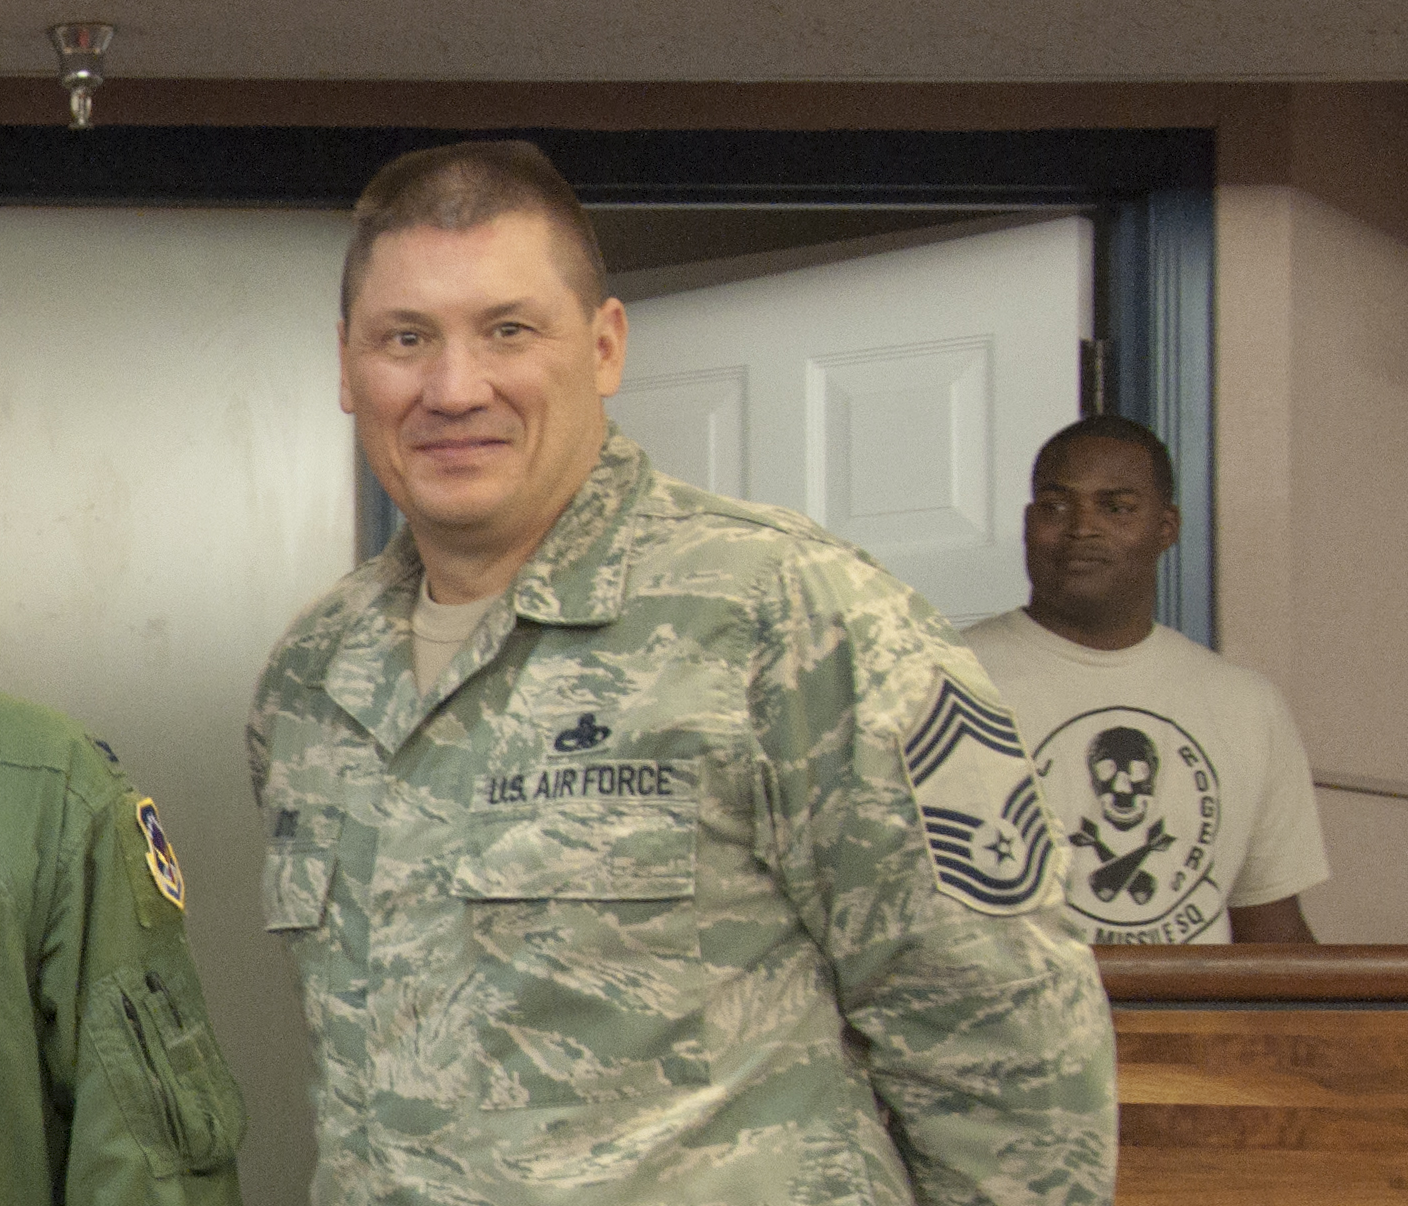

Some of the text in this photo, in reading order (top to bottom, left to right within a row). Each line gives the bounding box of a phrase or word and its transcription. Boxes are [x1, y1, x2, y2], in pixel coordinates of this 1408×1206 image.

[534, 768, 577, 799] AIR
[582, 764, 674, 797] FORCE
[1170, 745, 1215, 893] ROGERS
[1175, 903, 1205, 934] SQ
